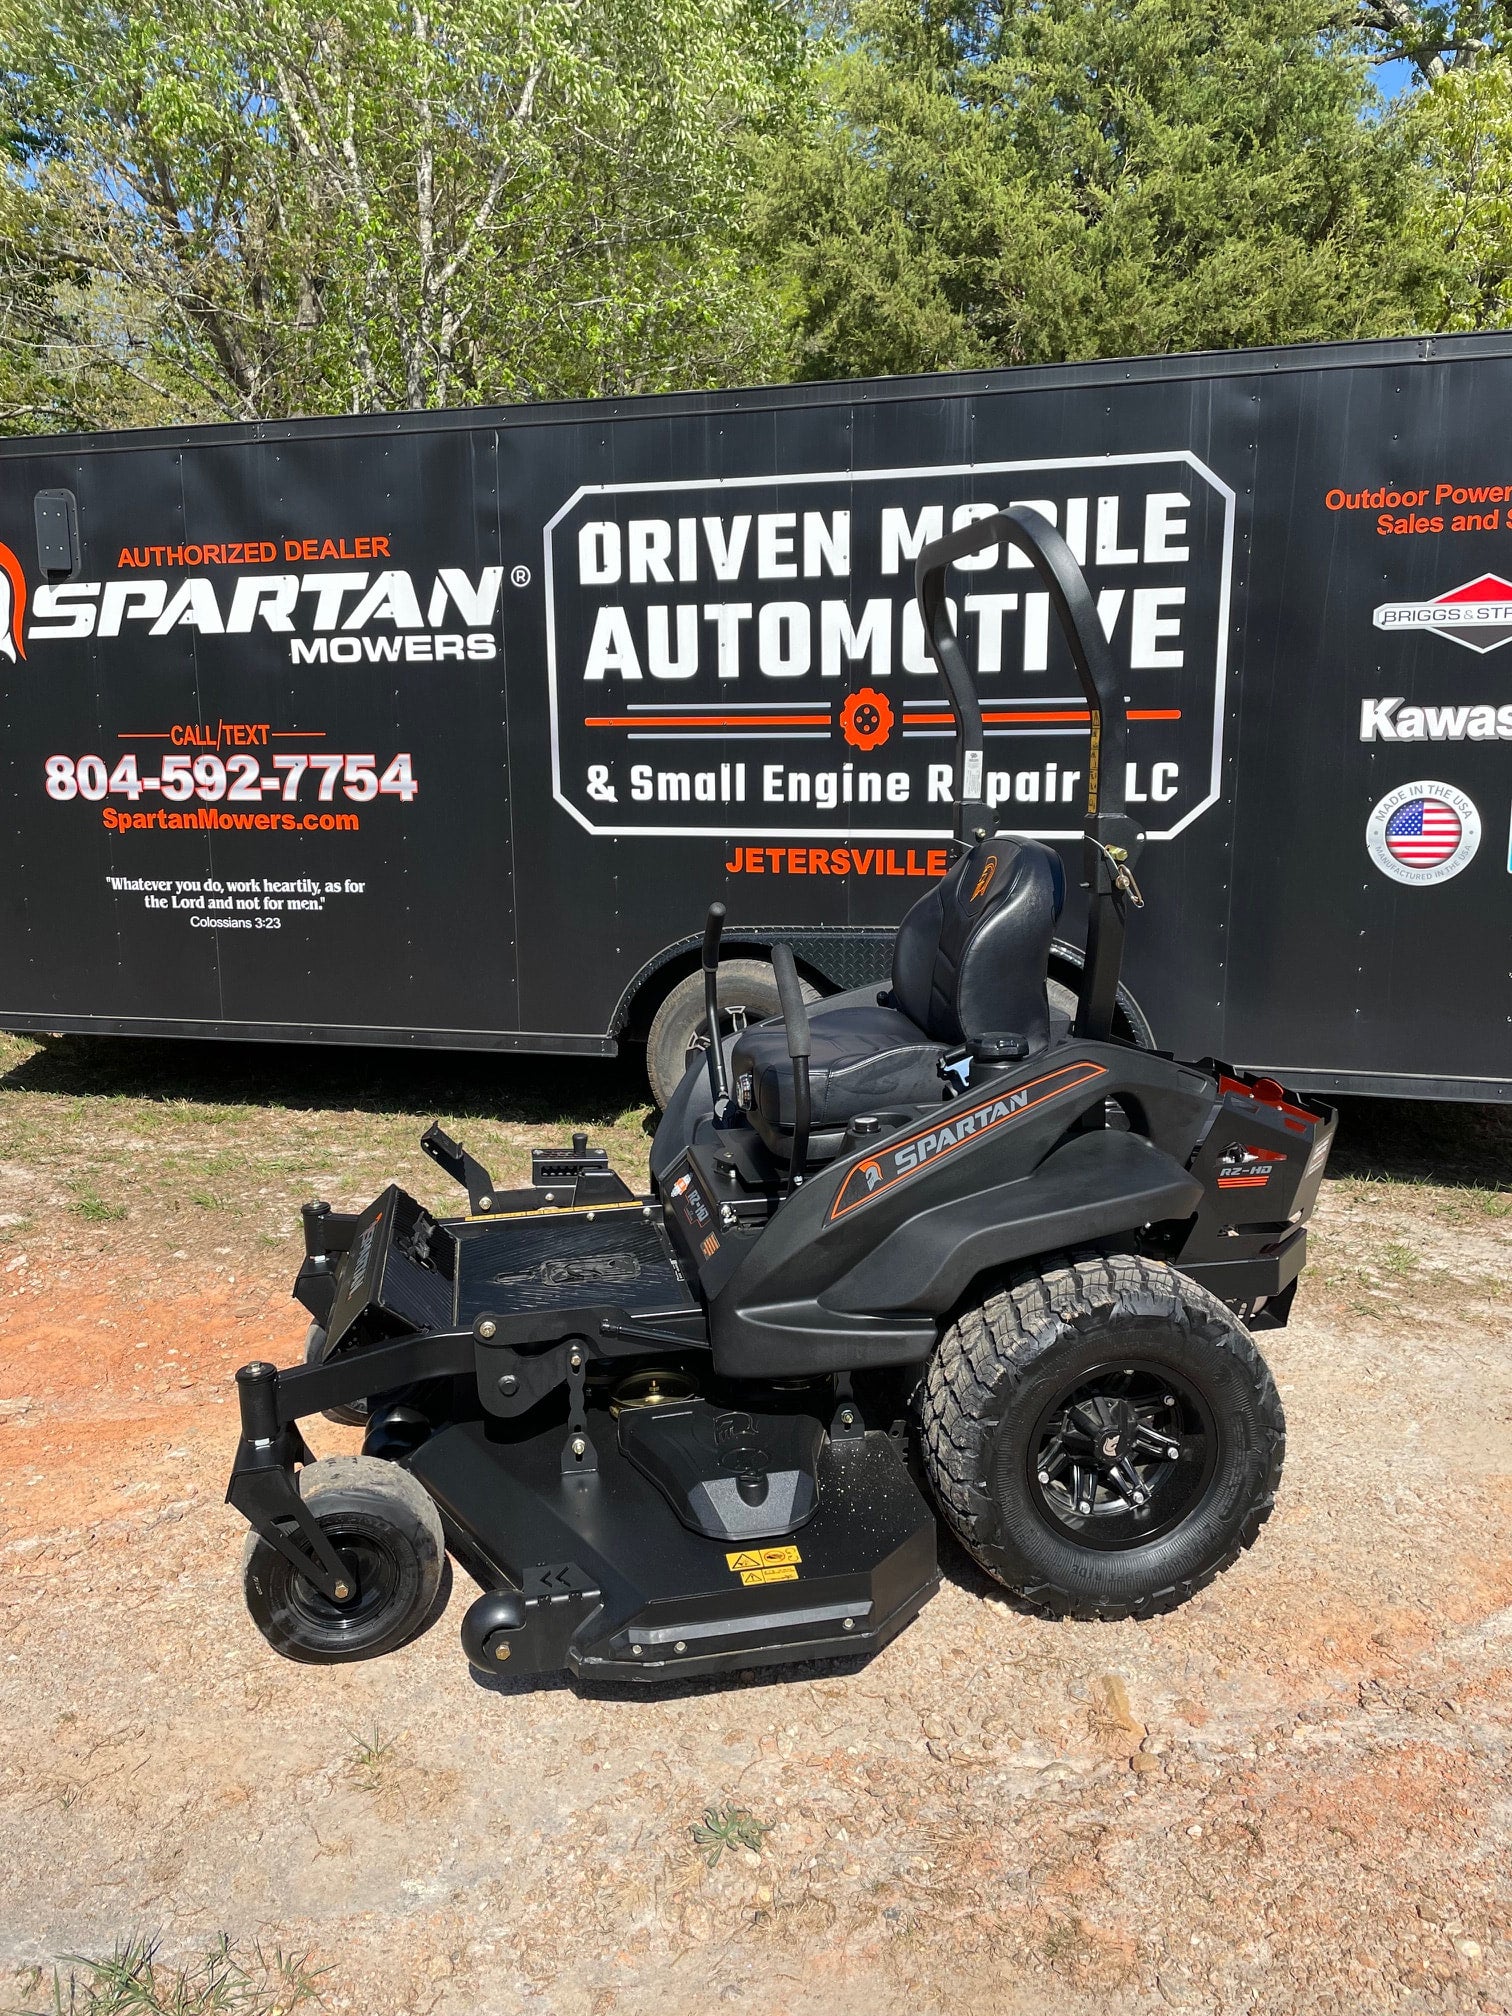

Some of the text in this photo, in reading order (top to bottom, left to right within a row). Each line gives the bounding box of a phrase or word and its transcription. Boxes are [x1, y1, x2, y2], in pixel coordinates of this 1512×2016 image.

[1326, 488, 1429, 510] Outdoor
[1377, 513, 1444, 535] Sales
[1451, 509, 1499, 531] and
[118, 537, 390, 567] AUTHORIZED DEALER
[579, 511, 851, 584] DRIVEN
[28, 567, 503, 640] SPARTAN
[1385, 608, 1461, 622] BRIGGS
[583, 587, 1186, 680] AUTOMOTIE
[291, 634, 497, 664] MOWERS
[171, 720, 270, 750] CALL/TEXT
[45, 753, 418, 801] 804-592-7754
[587, 765, 618, 802] &
[631, 763, 745, 801] Small
[764, 763, 909, 808] Engine
[928, 762, 1081, 809] Rpair
[1125, 762, 1179, 802] LC
[1375, 785, 1473, 821] MADE IN THE USA
[103, 808, 359, 833] SpartanMowers.com
[1375, 844, 1473, 881] MANUFACTURED IN THE USA
[106, 877, 365, 896] "Whatever you do, work heartily, as for
[144, 895, 325, 910] the Lord and not for men."
[190, 916, 281, 928] Colossians 3:23
[894, 1089, 1028, 1175] SPARTAN
[1219, 1165, 1273, 1177] RZ-HD
